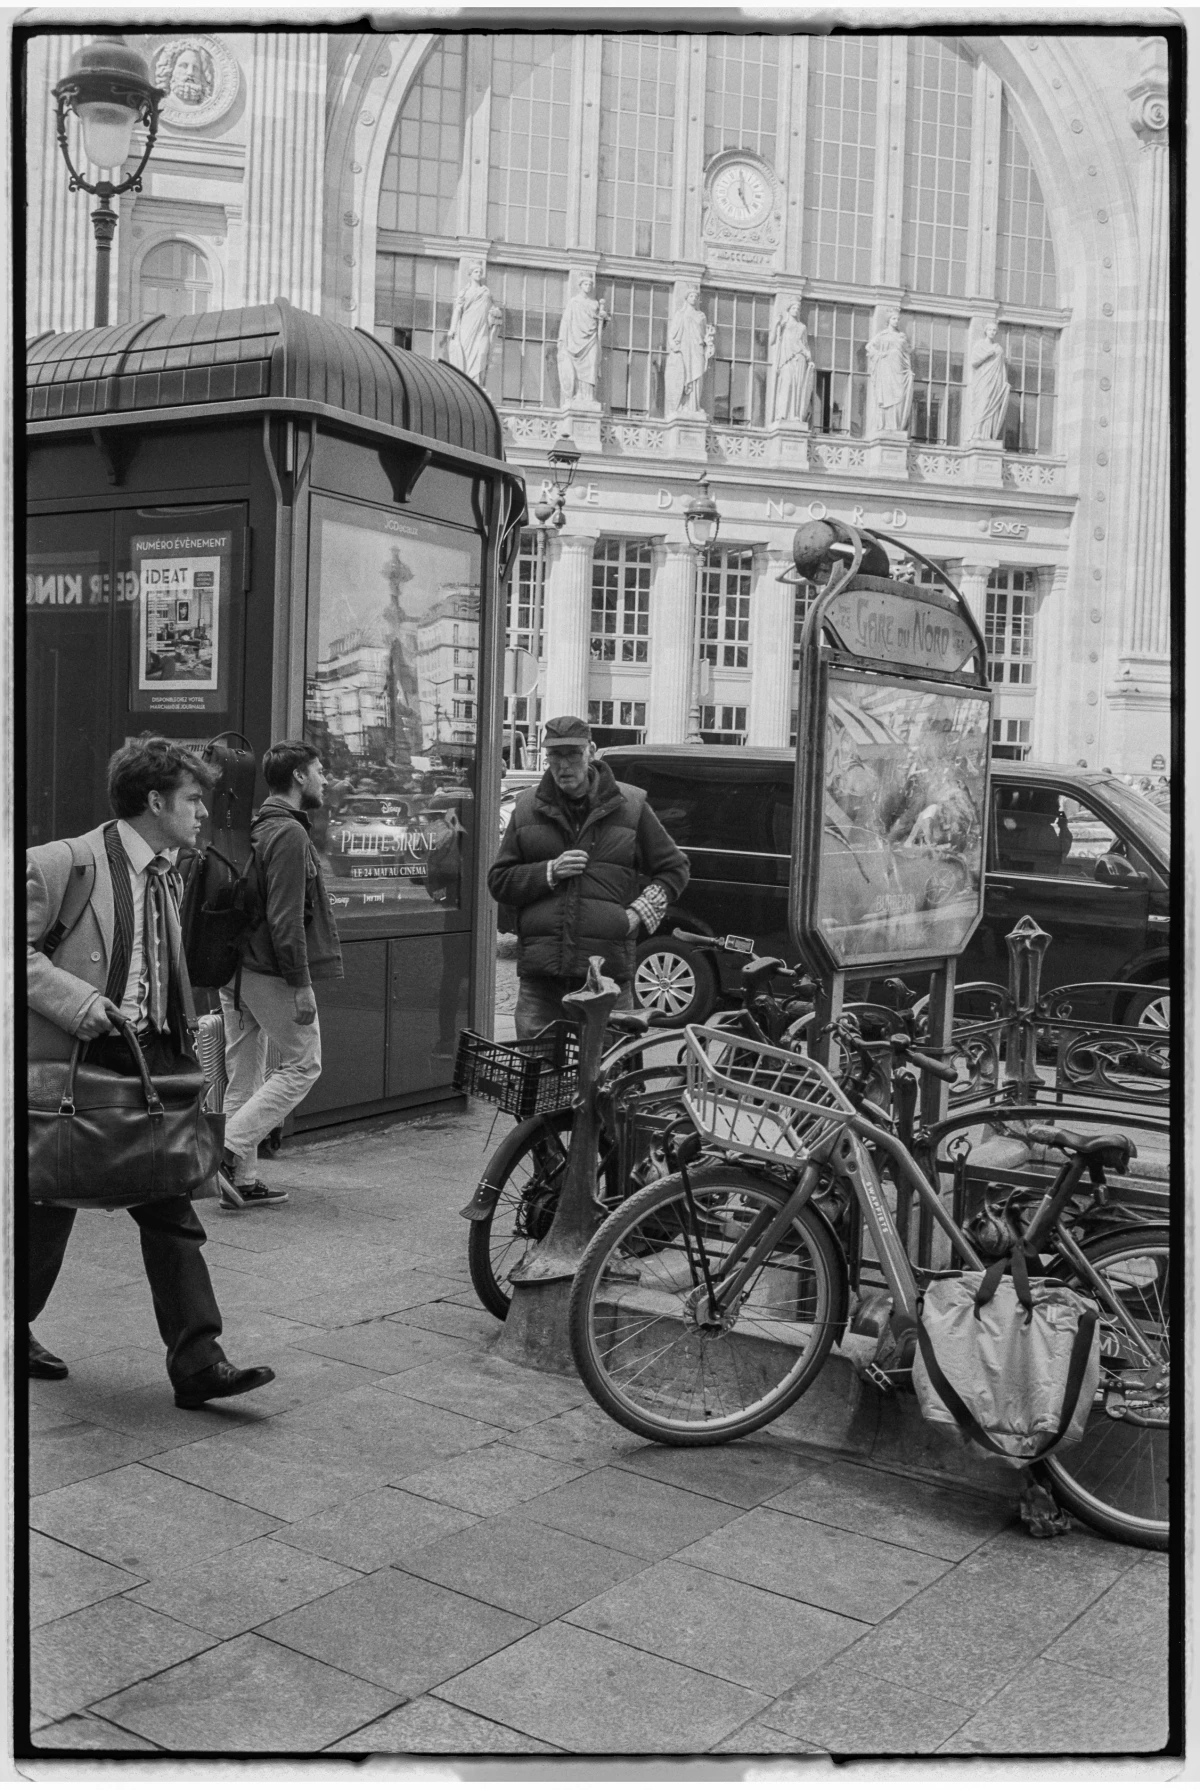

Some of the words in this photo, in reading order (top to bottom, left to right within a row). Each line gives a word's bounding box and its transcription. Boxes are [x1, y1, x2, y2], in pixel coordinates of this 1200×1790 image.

[541, 478, 599, 505] RE
[765, 496, 908, 529] NORD
[992, 521, 1027, 536] SNCF
[136, 539, 173, 551] NUMÉRO
[174, 537, 227, 550] ÉVÈNEMENT
[145, 567, 189, 585] IDEAT
[912, 609, 950, 660] NORD
[353, 868, 363, 878] LE
[364, 867, 373, 877] 24
[373, 867, 388, 877] MAI
[389, 866, 399, 876] AU
[399, 864, 427, 876] CINÉMA
[865, 1181, 889, 1234] SWAPFIETS
